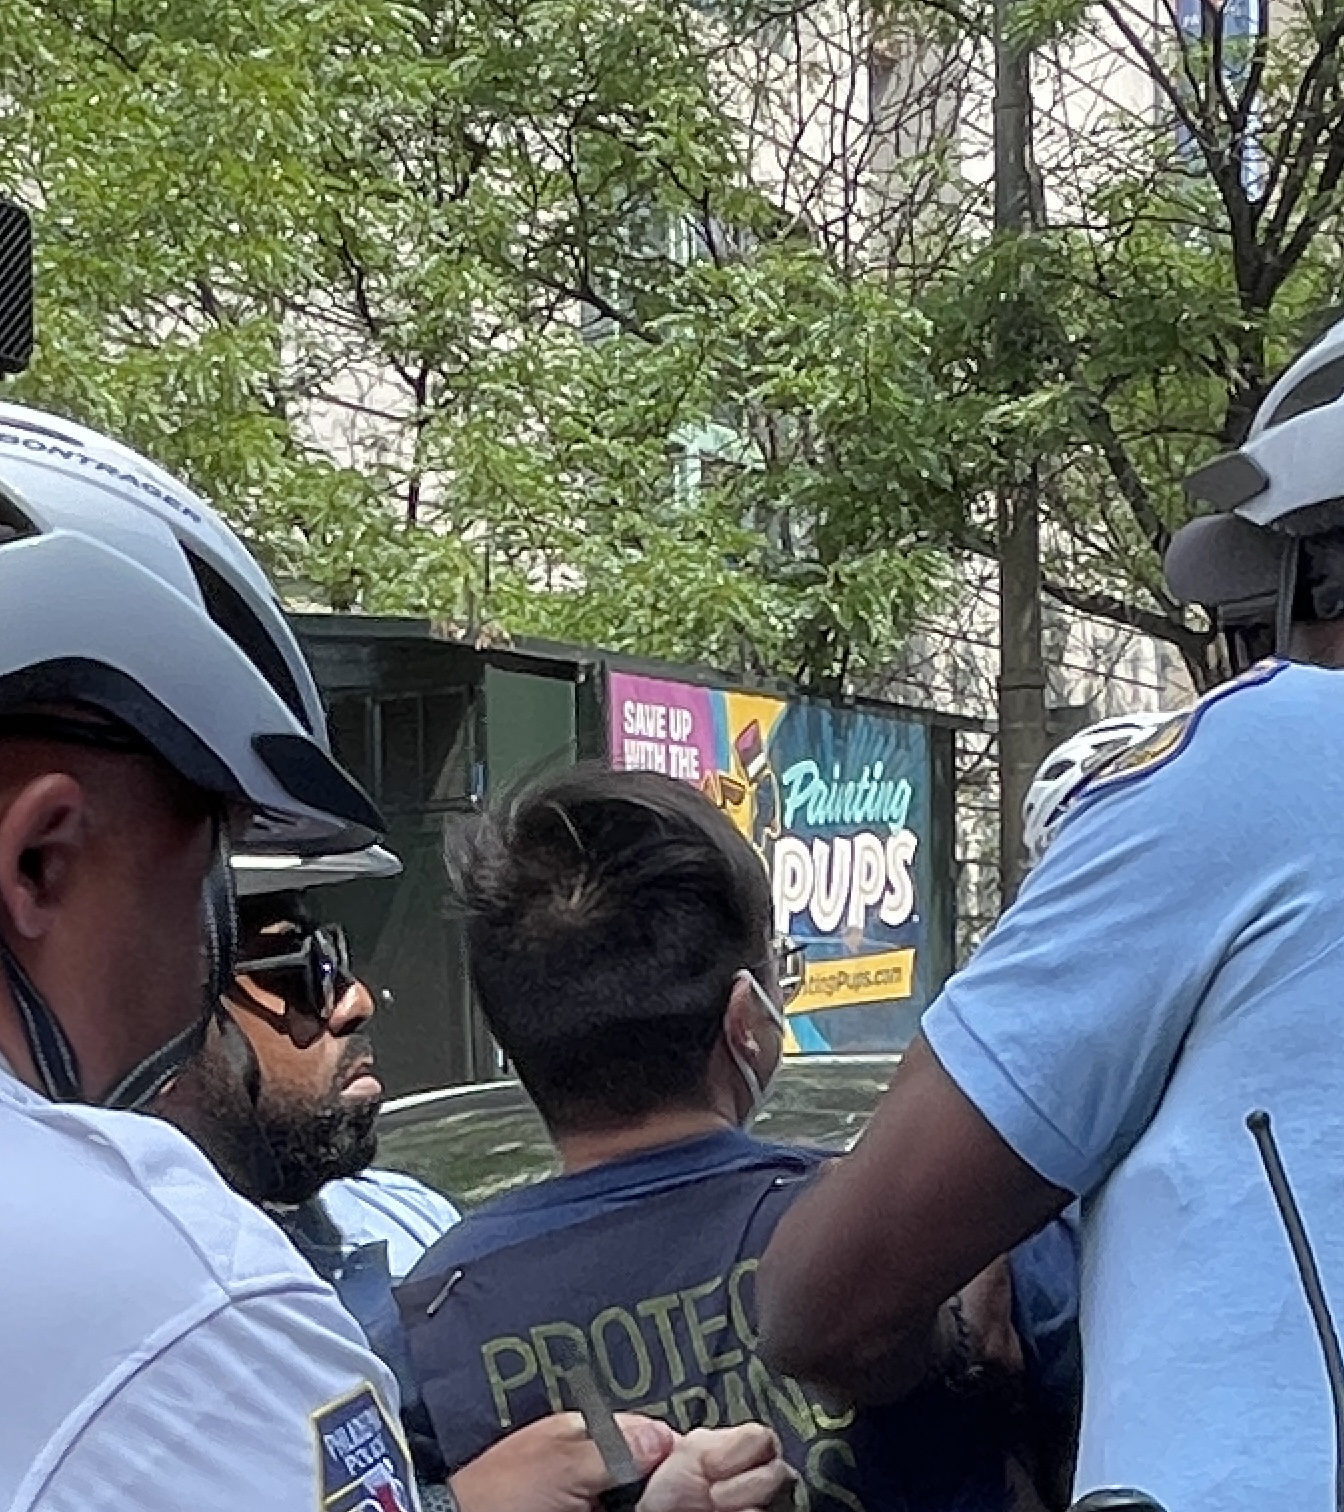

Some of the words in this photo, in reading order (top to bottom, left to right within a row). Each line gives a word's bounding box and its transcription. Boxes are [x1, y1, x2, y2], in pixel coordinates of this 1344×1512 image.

[623, 700, 666, 738] SAVE
[668, 706, 692, 742] UP
[623, 738, 666, 774] WITH
[668, 746, 700, 780] THE
[781, 759, 913, 833] Painting
[480, 1257, 759, 1429] PROTEC
